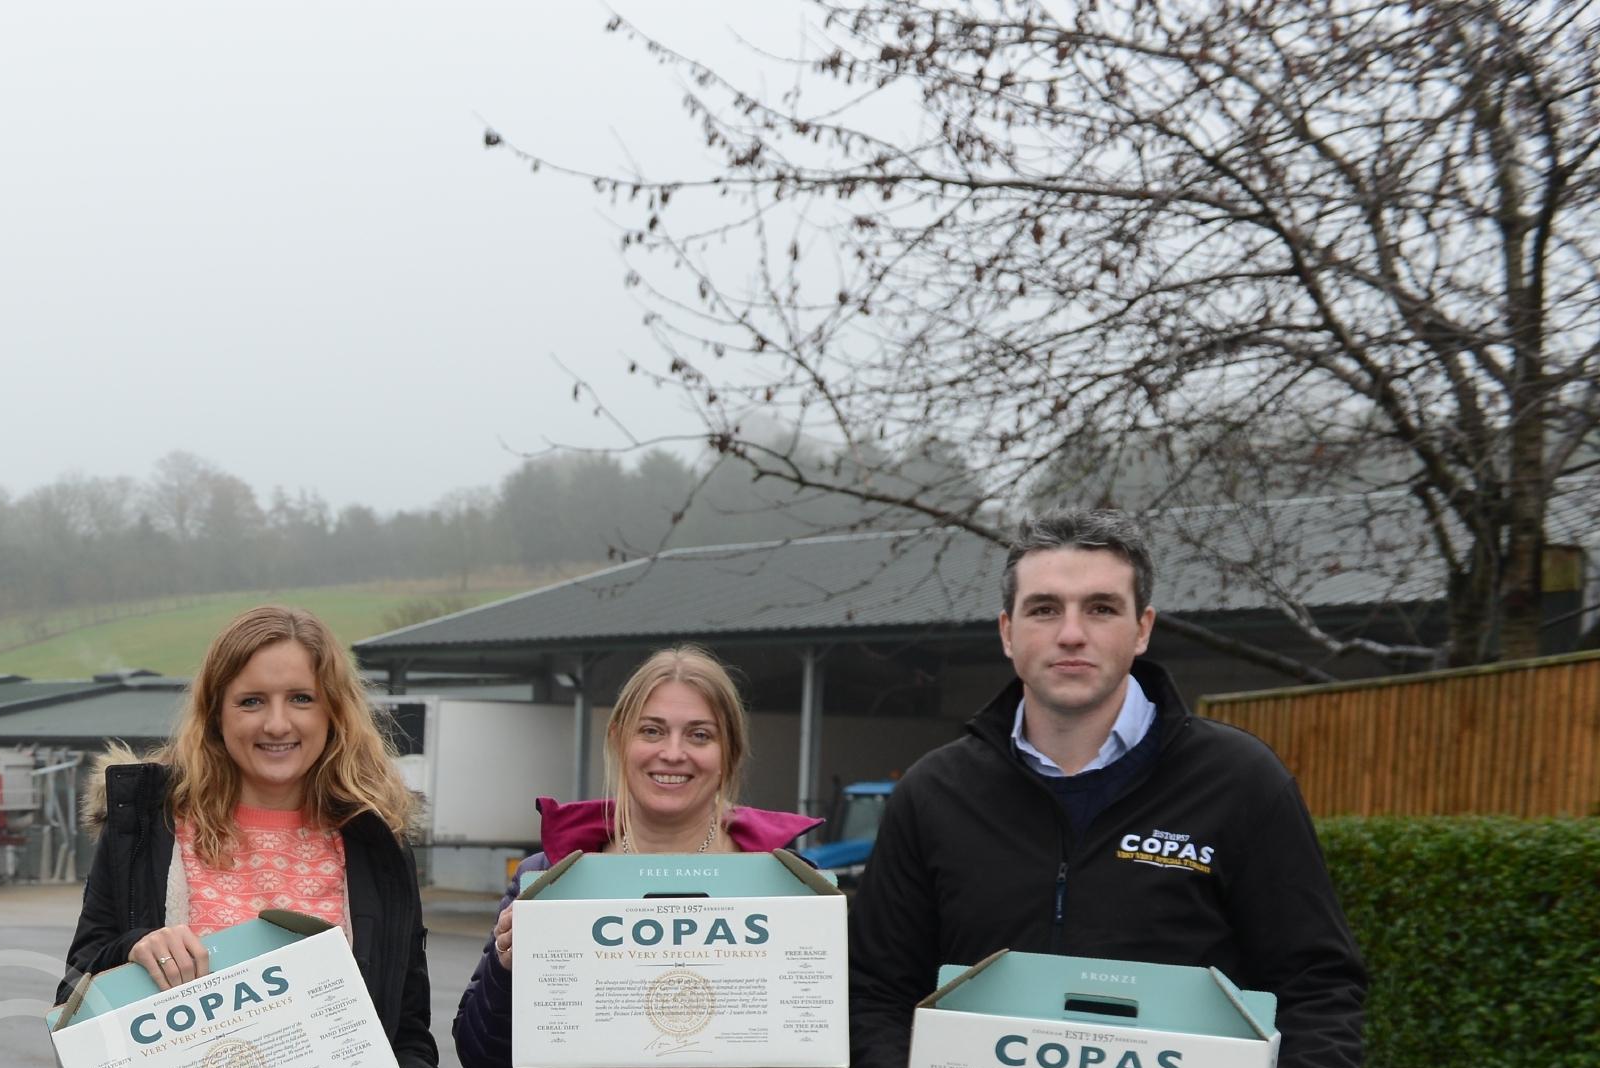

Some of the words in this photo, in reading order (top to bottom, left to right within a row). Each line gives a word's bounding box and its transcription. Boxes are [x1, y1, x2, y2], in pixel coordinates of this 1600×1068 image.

[1121, 834, 1215, 865] COPAS
[639, 868, 670, 877] FREE
[676, 868, 720, 877] RANGE
[682, 904, 703, 914] 1957
[591, 913, 769, 947] COPAS
[594, 950, 624, 959] VERY
[628, 949, 657, 959] VERY
[662, 949, 710, 959] SPECIAL
[714, 948, 767, 958] TURKEYS
[202, 976, 221, 990] 1957
[1081, 971, 1137, 985] BRONZE
[129, 965, 289, 1044] COPAS
[139, 1042, 167, 1057] VERY
[169, 1031, 197, 1046] VERY
[200, 1015, 244, 1036] SPECIAL
[244, 996, 293, 1018] TURKEYS
[1092, 1032, 1115, 1043] 1957
